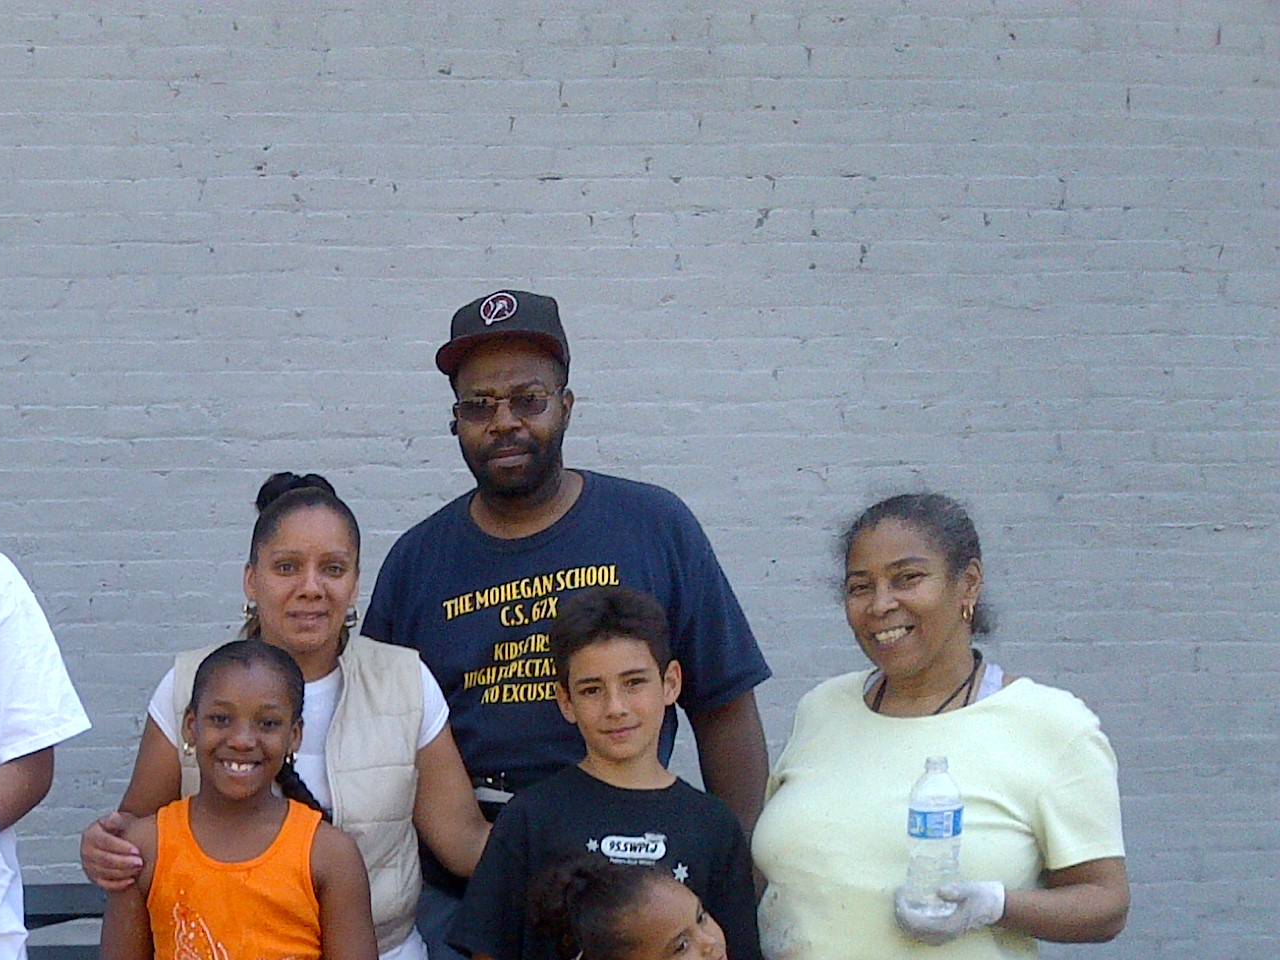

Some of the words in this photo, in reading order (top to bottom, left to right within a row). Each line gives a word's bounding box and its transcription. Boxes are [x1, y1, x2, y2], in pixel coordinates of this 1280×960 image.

[442, 592, 474, 620] THE
[475, 574, 554, 609] MOHEGAN
[556, 564, 619, 591] SCHOOL
[500, 604, 529, 626] C.S.
[532, 597, 559, 622] 67X
[493, 639, 524, 661] KIDS
[464, 666, 497, 690] HIGH
[481, 684, 500, 704] NO
